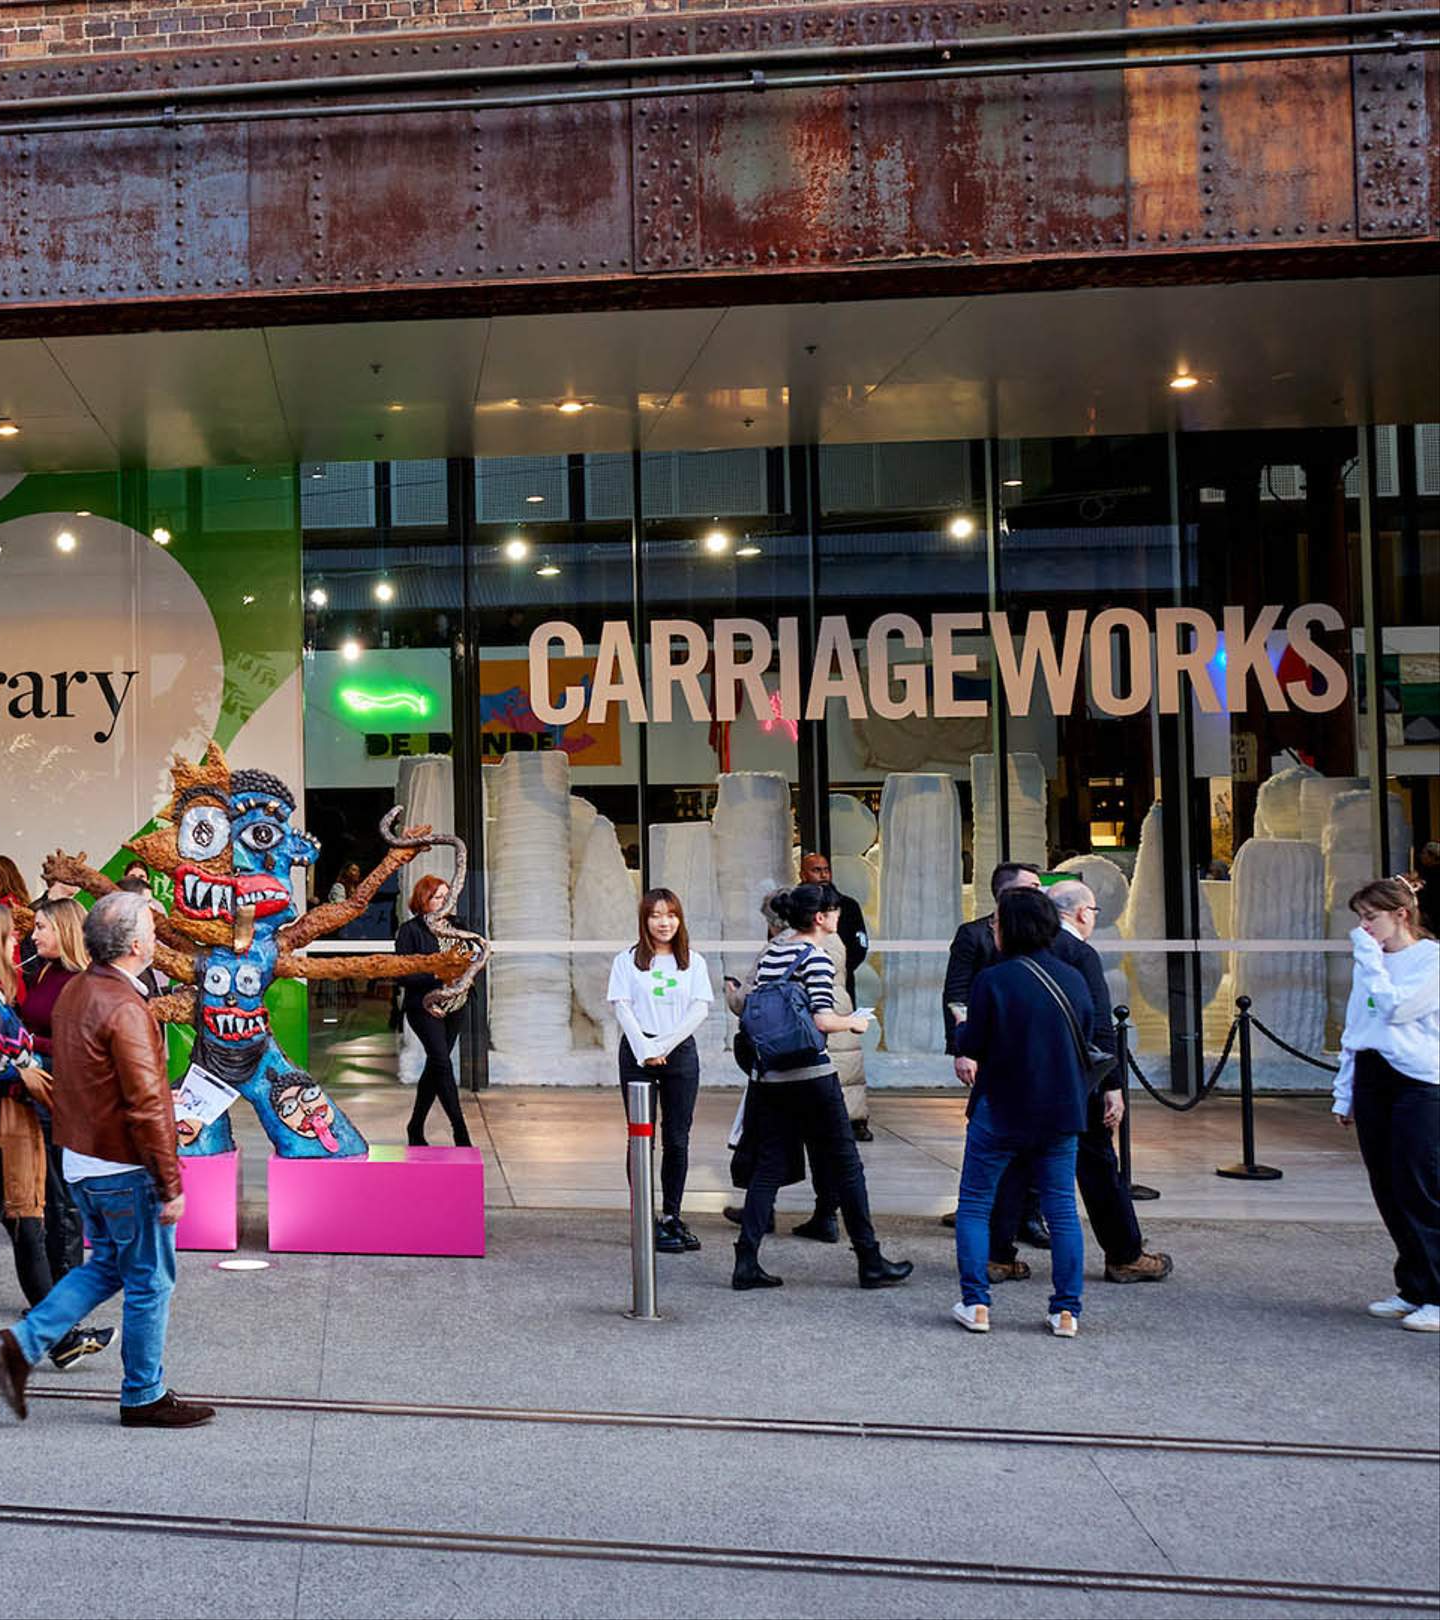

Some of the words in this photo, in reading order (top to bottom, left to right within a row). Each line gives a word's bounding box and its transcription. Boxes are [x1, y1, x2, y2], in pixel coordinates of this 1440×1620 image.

[527, 602, 1349, 725] CARRIAGEWORKS
[365, 732, 410, 756] DE
[428, 732, 553, 756] DNDE
